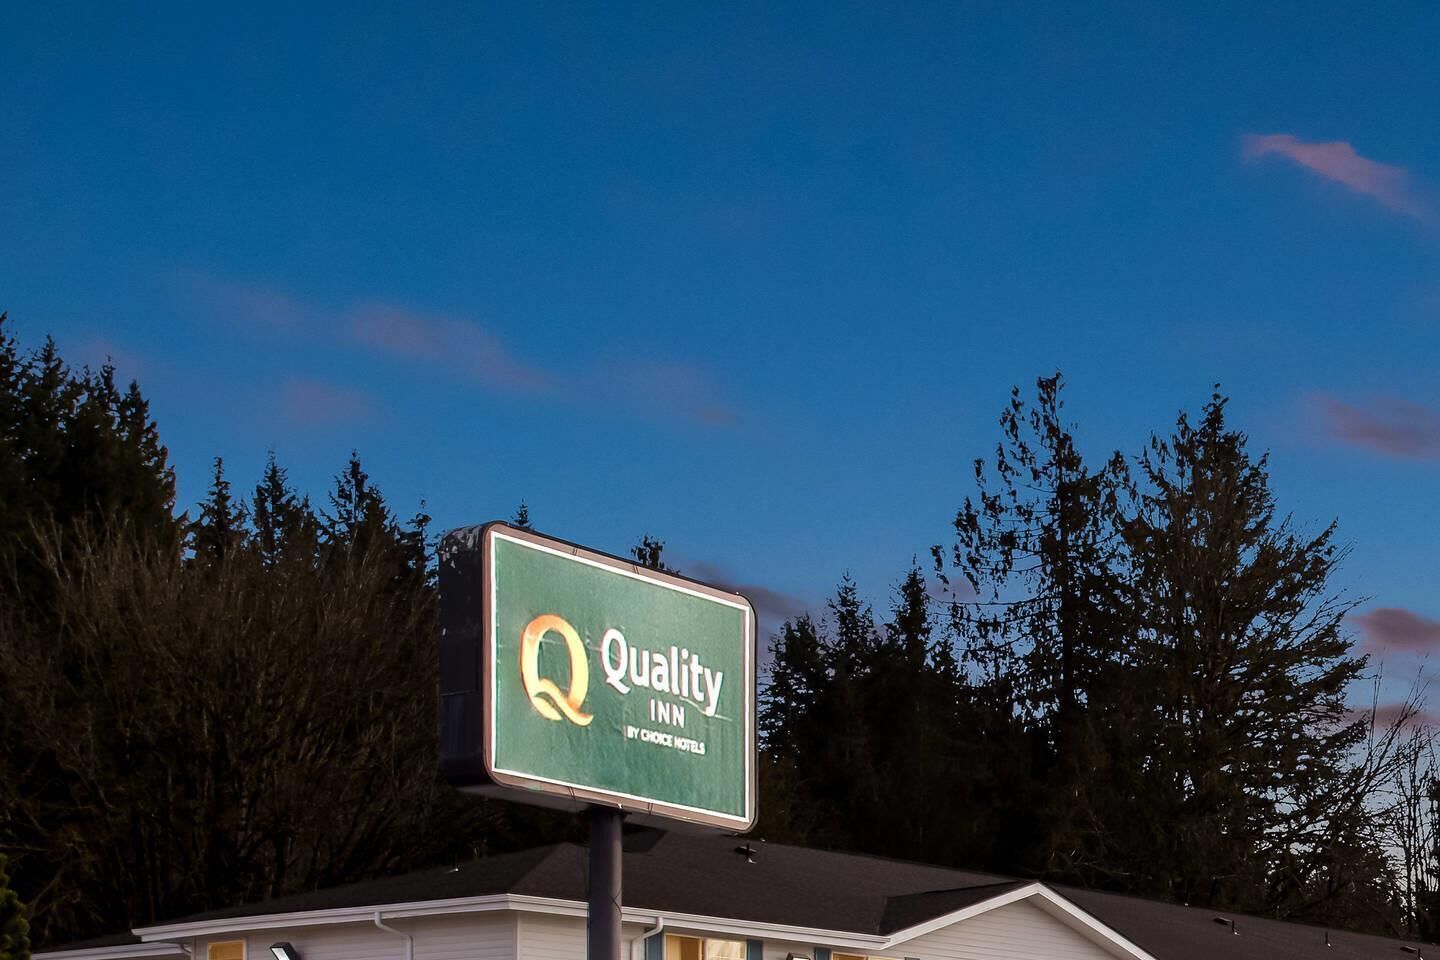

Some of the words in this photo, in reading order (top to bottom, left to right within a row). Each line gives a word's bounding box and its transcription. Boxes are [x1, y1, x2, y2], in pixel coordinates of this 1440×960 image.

[519, 614, 594, 728] Q
[600, 628, 723, 717] Quality
[626, 725, 640, 739] BY
[640, 728, 673, 748] CHOICE
[674, 735, 706, 755] HOTELS
[649, 698, 685, 728] INN
